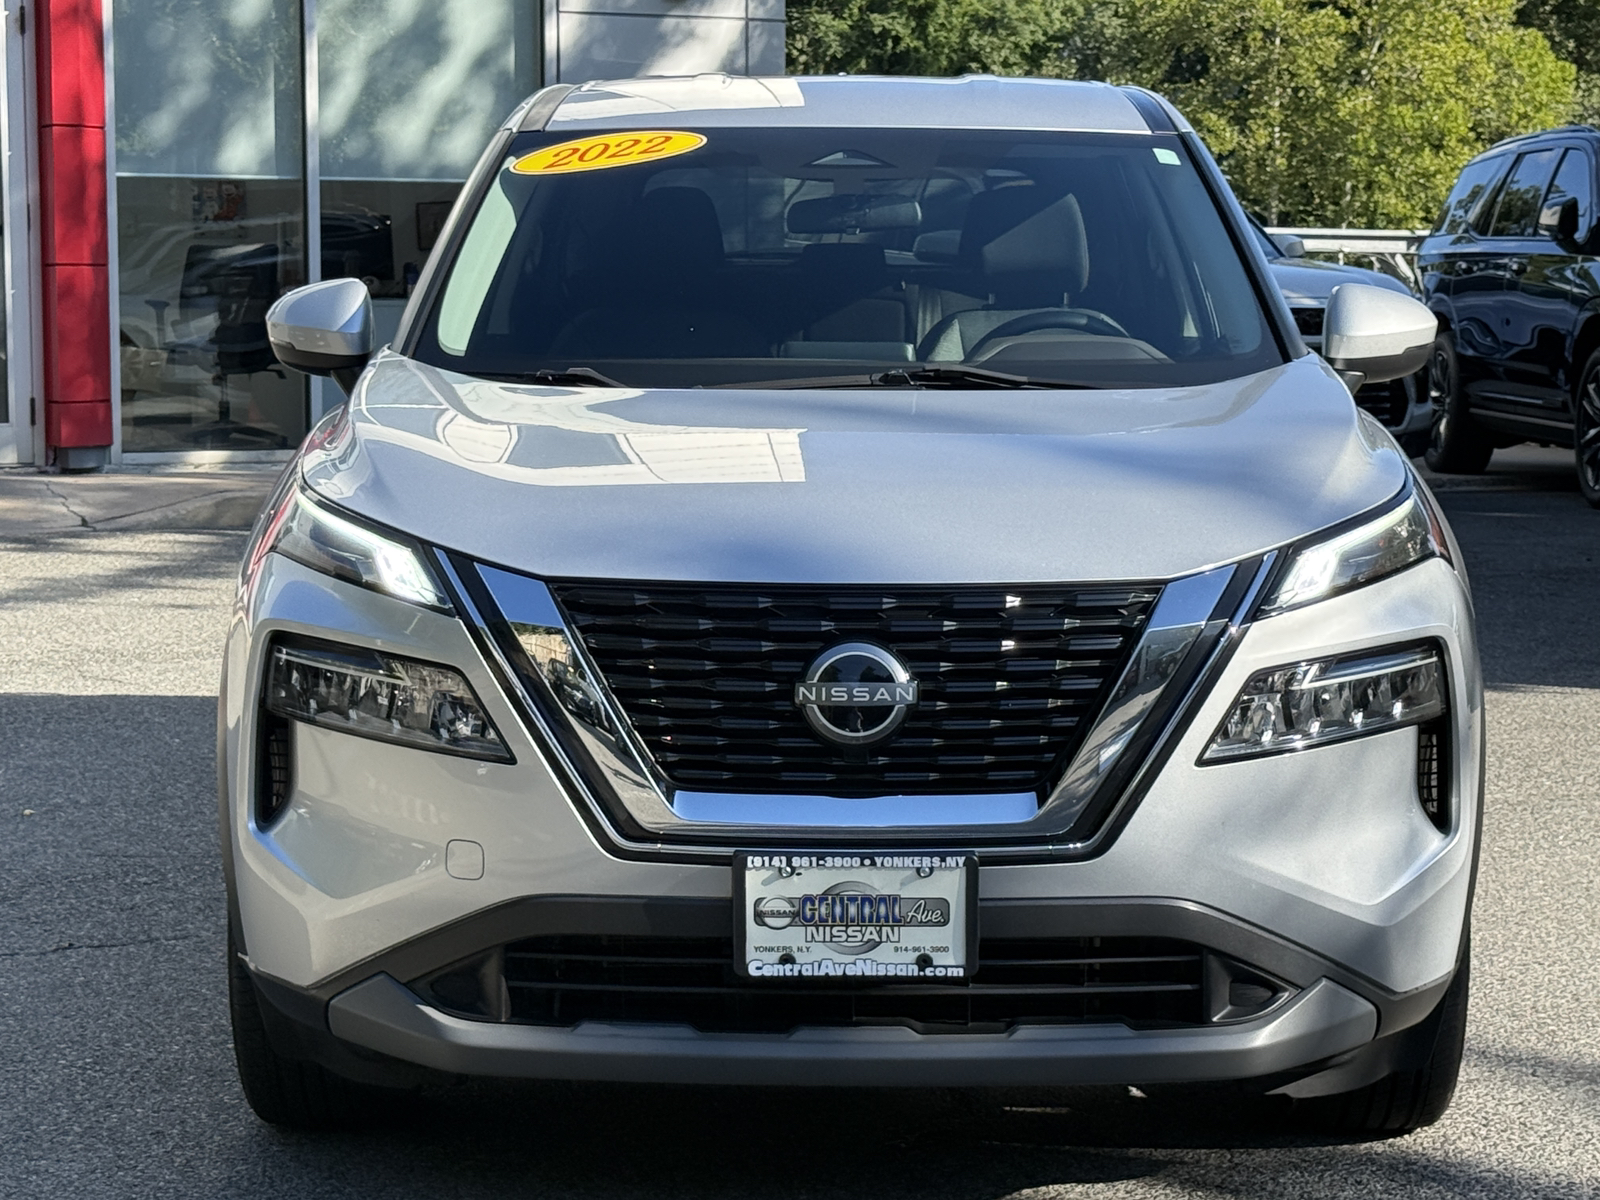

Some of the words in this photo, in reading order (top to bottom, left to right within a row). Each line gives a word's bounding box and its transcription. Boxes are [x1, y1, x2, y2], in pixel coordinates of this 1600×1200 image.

[543, 136, 673, 169] 2022
[798, 686, 914, 702] NISSAN
[792, 856, 861, 868] 961-3900
[800, 894, 905, 926] CENTRAL
[906, 899, 946, 924] Ave.
[805, 926, 900, 943] NISSAN
[754, 946, 795, 954] YONKERS,
[748, 959, 964, 977] CentralAveNissan.com
